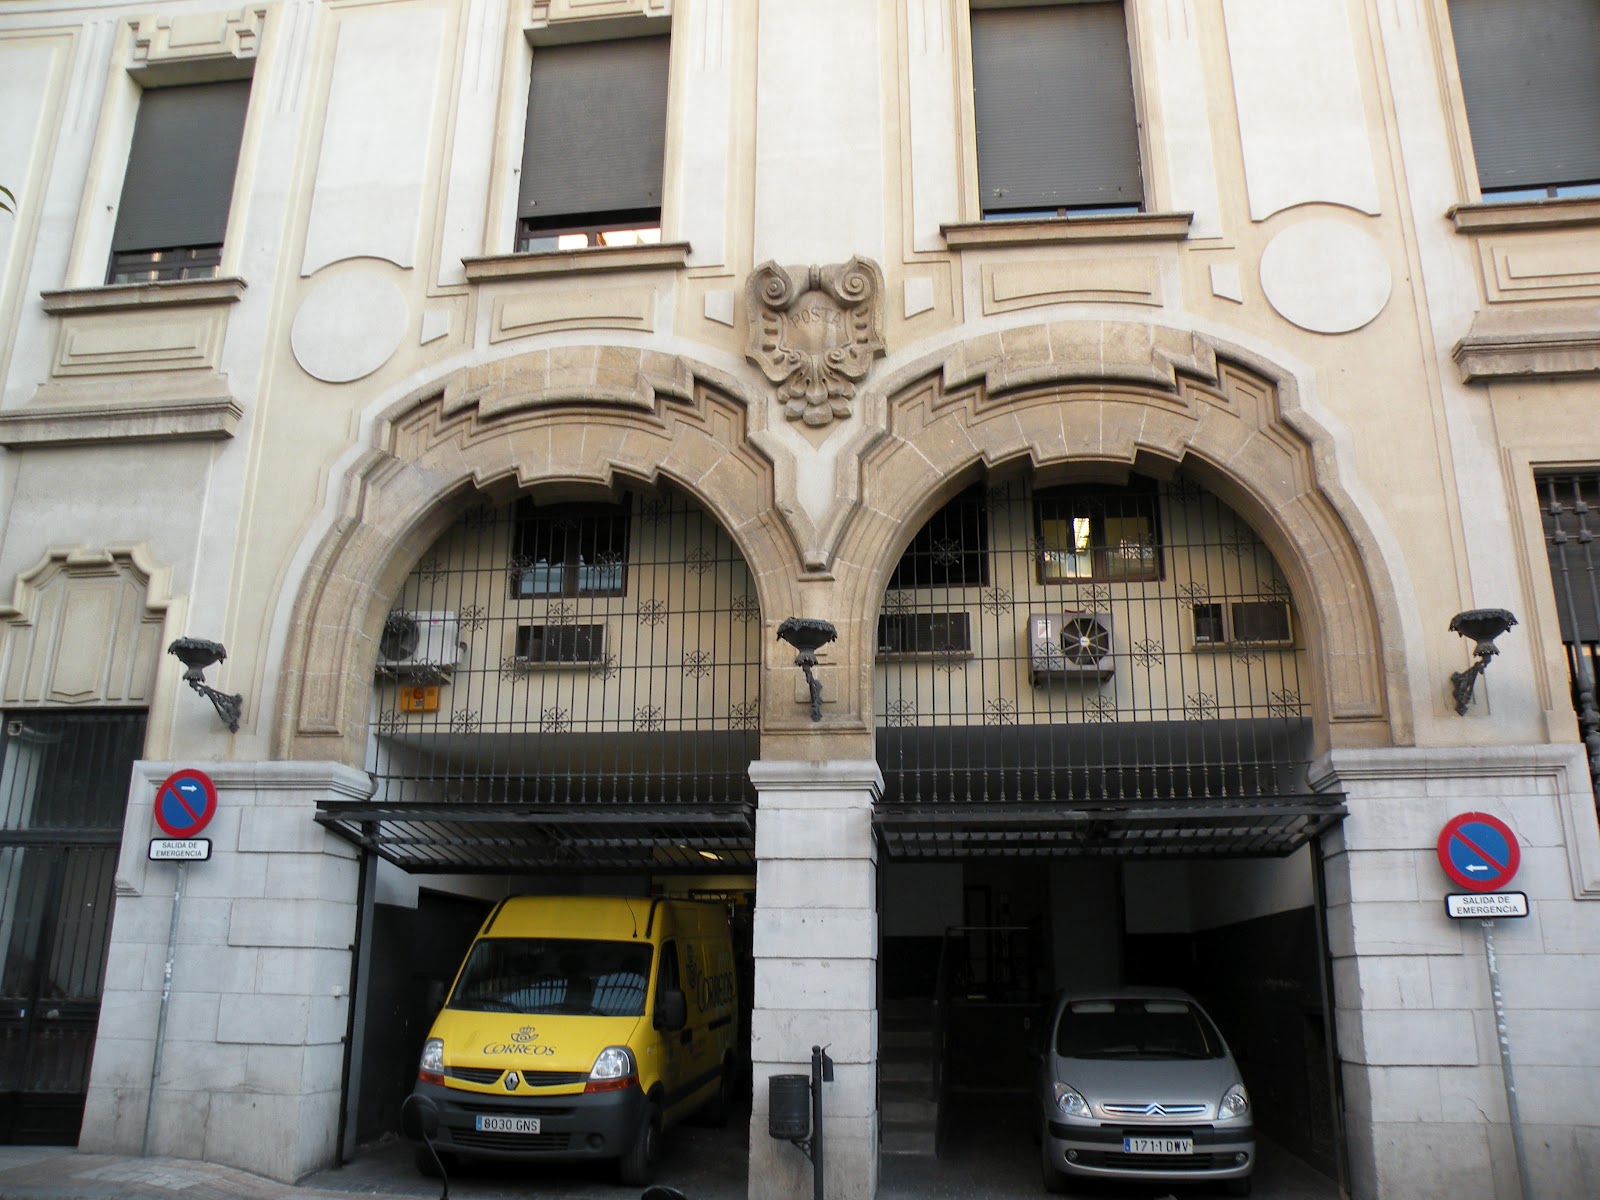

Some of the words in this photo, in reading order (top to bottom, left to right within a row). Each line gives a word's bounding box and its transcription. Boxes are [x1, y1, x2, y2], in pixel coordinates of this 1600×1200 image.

[1462, 896, 1495, 905] SALIDA
[1497, 896, 1511, 904] DE
[1457, 905, 1519, 915] EMERGENCIA
[483, 1042, 557, 1056] CORREOS
[484, 1118, 512, 1130] 8030
[516, 1120, 538, 1132] GNS
